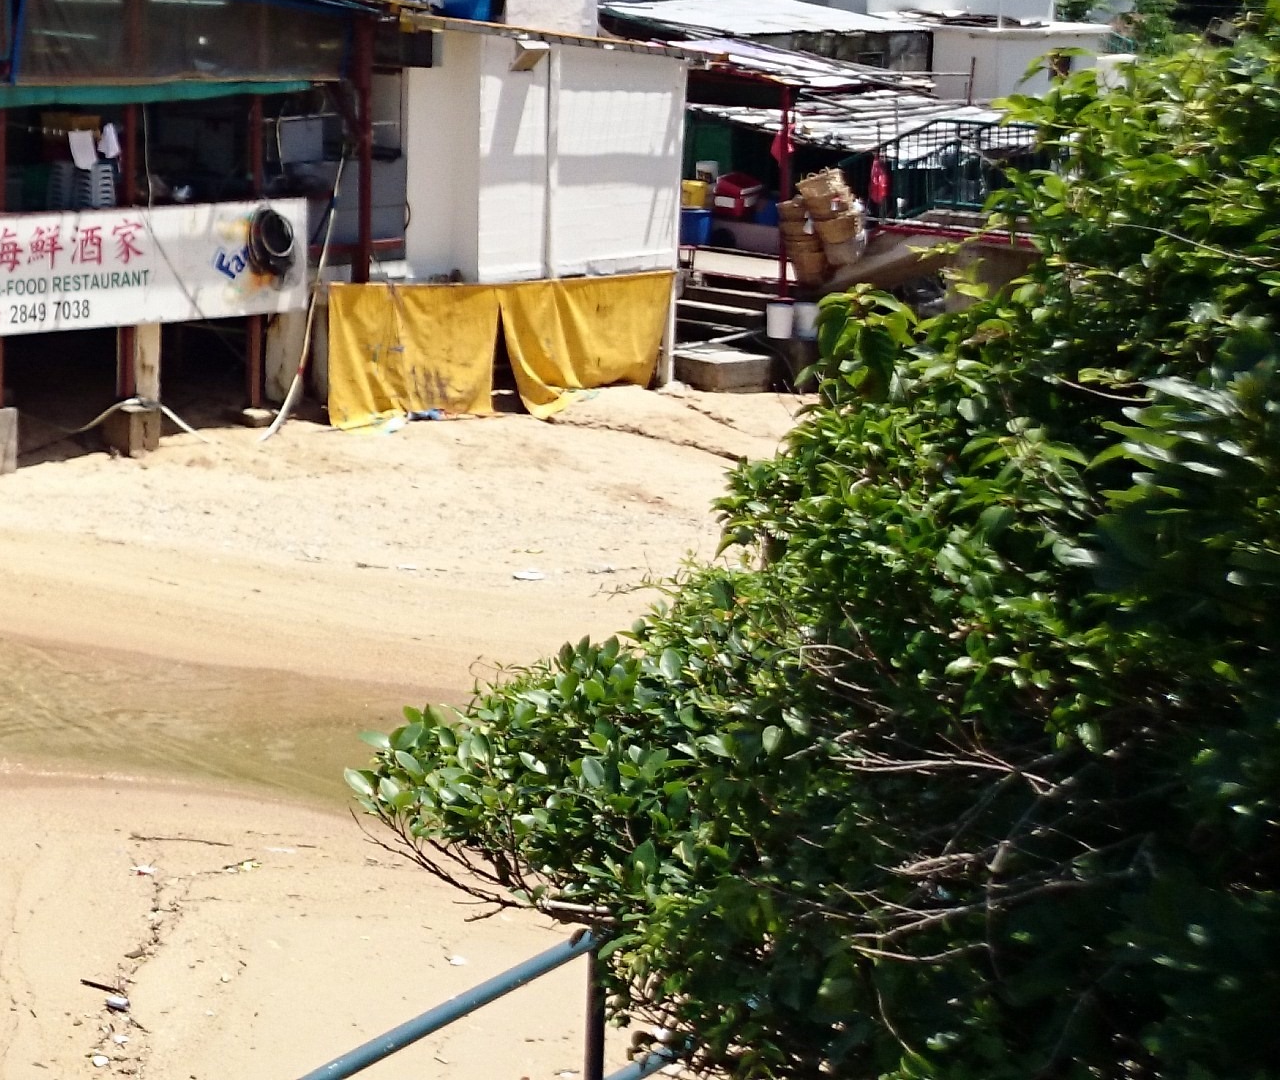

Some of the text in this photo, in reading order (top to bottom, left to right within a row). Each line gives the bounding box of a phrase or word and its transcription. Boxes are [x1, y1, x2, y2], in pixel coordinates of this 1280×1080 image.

[52, 269, 150, 293] RESTAURANT
[10, 302, 46, 324] 2849
[52, 299, 90, 321] 7038
